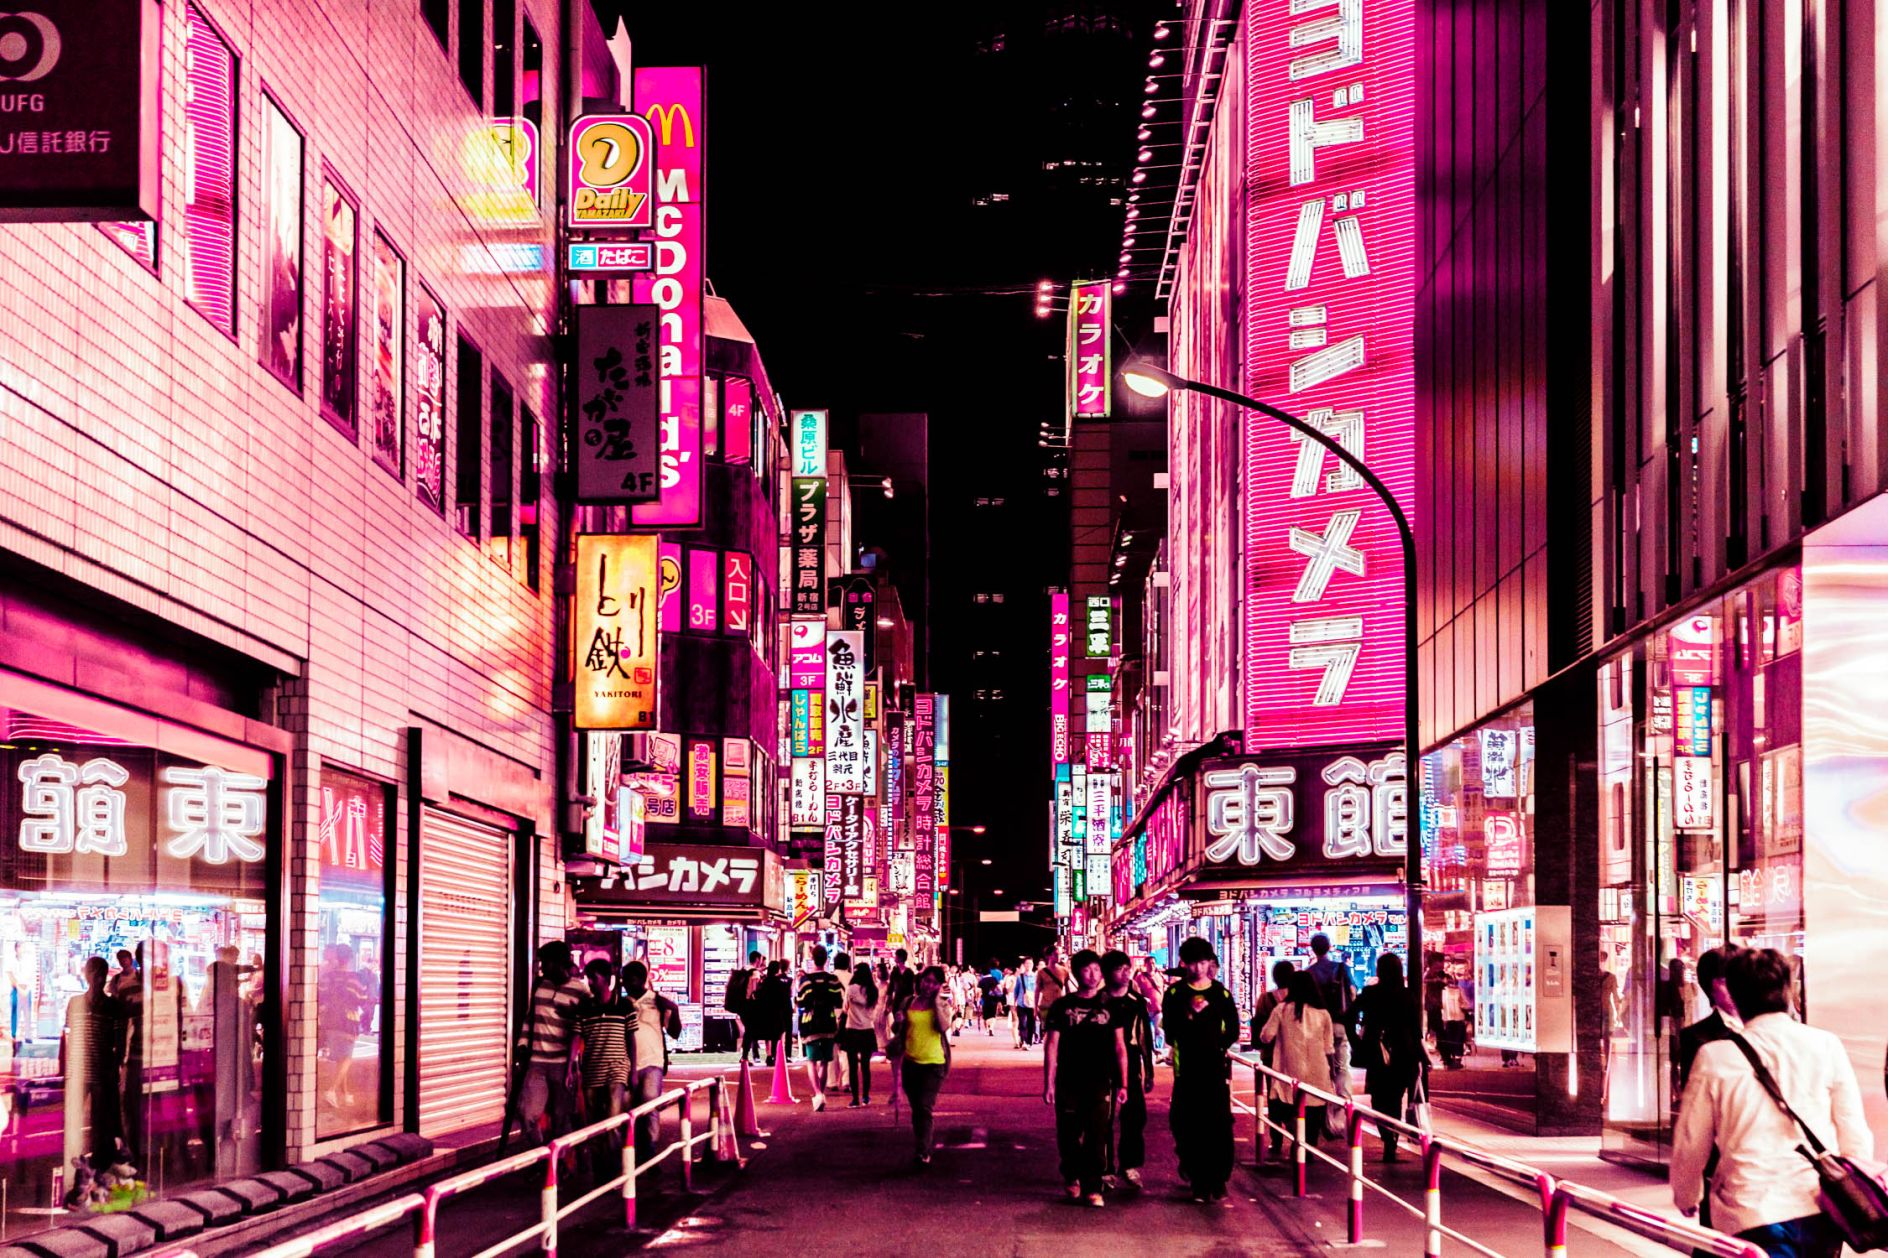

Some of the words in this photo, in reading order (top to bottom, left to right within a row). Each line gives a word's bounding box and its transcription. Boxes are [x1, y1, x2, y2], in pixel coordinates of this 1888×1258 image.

[1, 94, 44, 112] UFG
[576, 188, 647, 218] Daily
[575, 249, 594, 265] 酒
[600, 248, 646, 265] たばこ
[1078, 293, 1104, 405] カラオケ
[728, 404, 746, 416] 4F
[800, 413, 819, 475] 桑原ビル
[621, 472, 653, 492] 4F
[798, 480, 820, 590] プラザ薬局
[728, 558, 747, 602] 入口
[692, 604, 715, 625] 3F
[792, 653, 823, 664] アコム
[1053, 612, 1067, 690] カラオケ
[801, 676, 816, 686] 3F
[594, 690, 642, 698] YAKITORI
[828, 752, 858, 762] 三代目
[645, 797, 676, 815] 号店
[1204, 752, 1407, 866] 東館
[825, 795, 842, 904] ヨドバシカメラ
[1219, 888, 1289, 900] ヨドバシカメラ
[1298, 911, 1388, 926] ヨドバシカメラ
